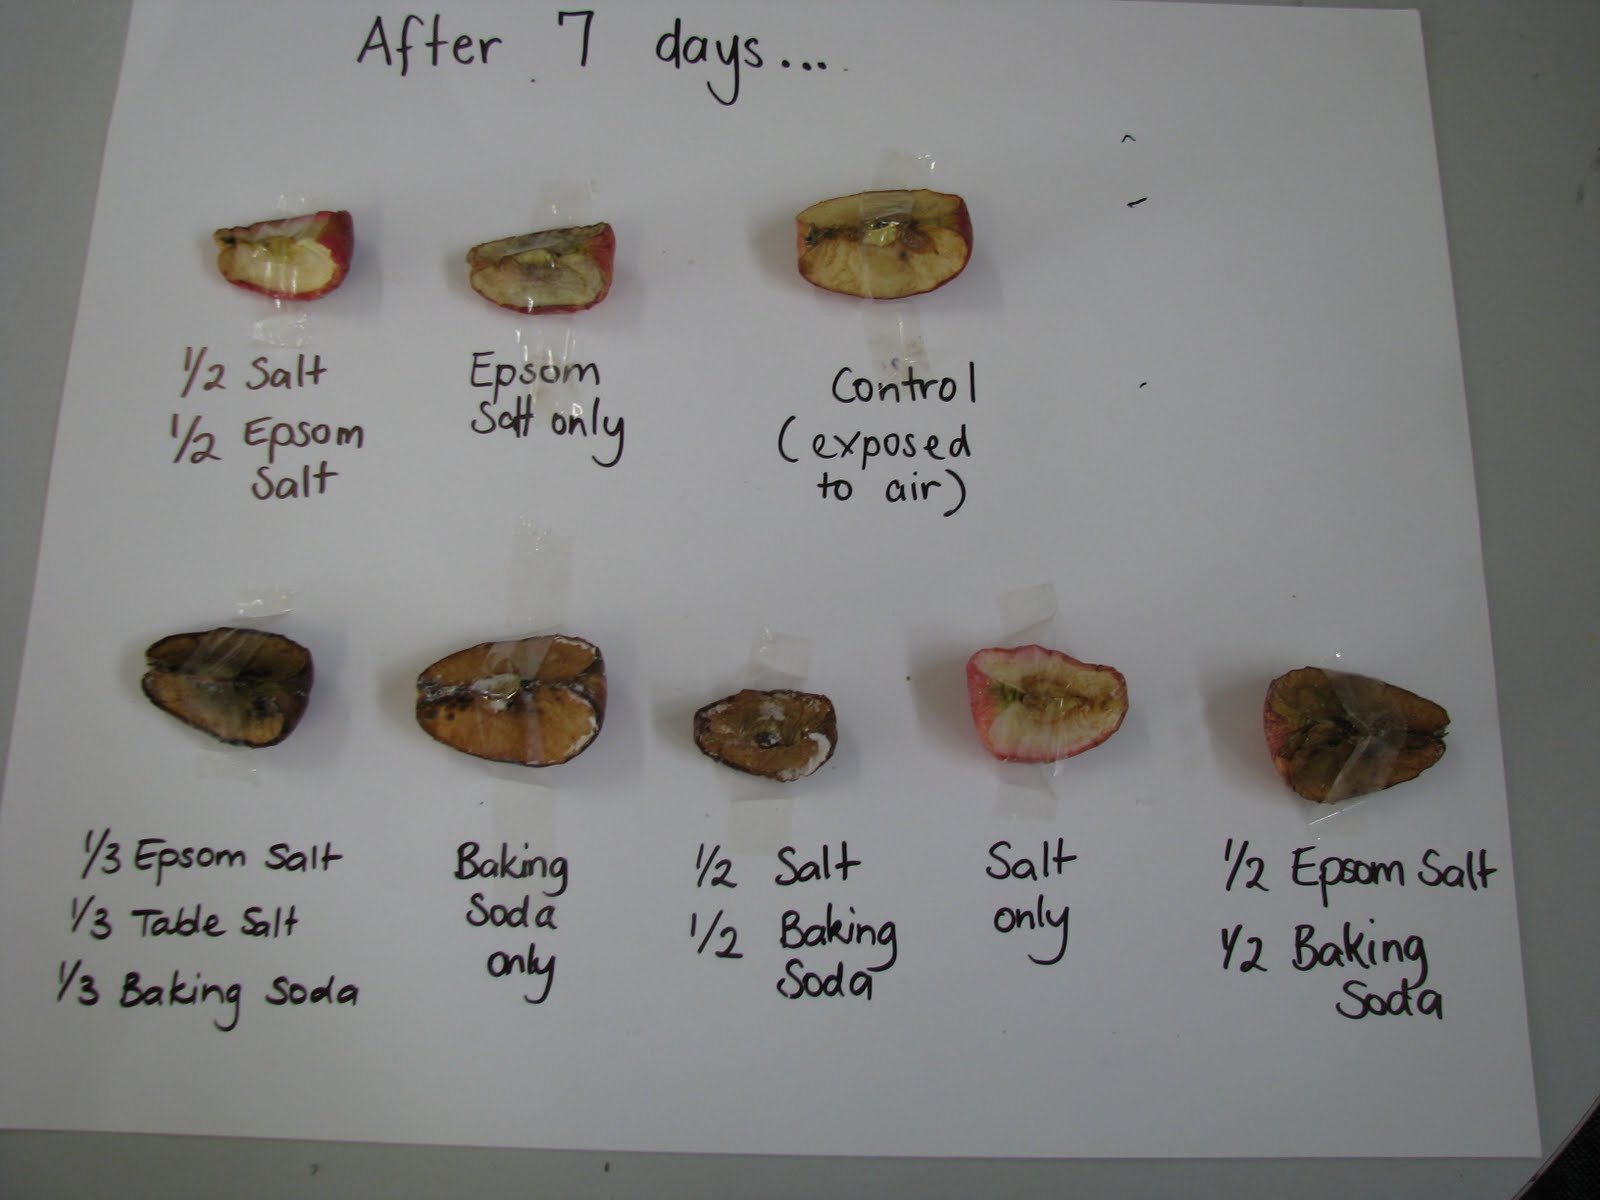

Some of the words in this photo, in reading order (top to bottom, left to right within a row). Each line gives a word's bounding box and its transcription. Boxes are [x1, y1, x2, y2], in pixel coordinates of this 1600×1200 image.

[356, 14, 503, 77] After
[557, 9, 595, 68] 7
[180, 346, 226, 398] 1/2
[245, 353, 328, 391] Salt
[470, 350, 601, 405] Epsom
[831, 360, 978, 405] Control
[171, 413, 223, 465] 1/2
[243, 416, 364, 465] Epsom
[550, 396, 626, 469] only
[251, 460, 339, 501] Salt
[816, 471, 853, 503] to
[885, 468, 968, 518] air)
[81, 827, 123, 880] 1/3
[133, 837, 252, 887] Epsom
[264, 841, 344, 873] Salt
[453, 841, 570, 898] Baking
[695, 842, 739, 889] 1/2
[774, 840, 862, 887] Salt
[985, 837, 1079, 882] Salt
[1223, 837, 1270, 893] 1/2
[1290, 845, 1406, 909] Epsom
[1417, 848, 1498, 892] Salt
[71, 894, 113, 941] 1/3
[131, 903, 227, 938] Table
[240, 904, 300, 938] Salt
[465, 892, 559, 931] Soda
[690, 909, 744, 960] 1/2
[779, 901, 898, 973] Baking
[993, 893, 1070, 966] only
[486, 942, 557, 1005] only
[1291, 917, 1428, 988] Baking
[56, 959, 100, 1006] 1/3
[118, 969, 243, 1033] Baking
[264, 974, 360, 1007] Soda
[775, 957, 874, 1002] Soda
[1335, 978, 1444, 1021] Soda
